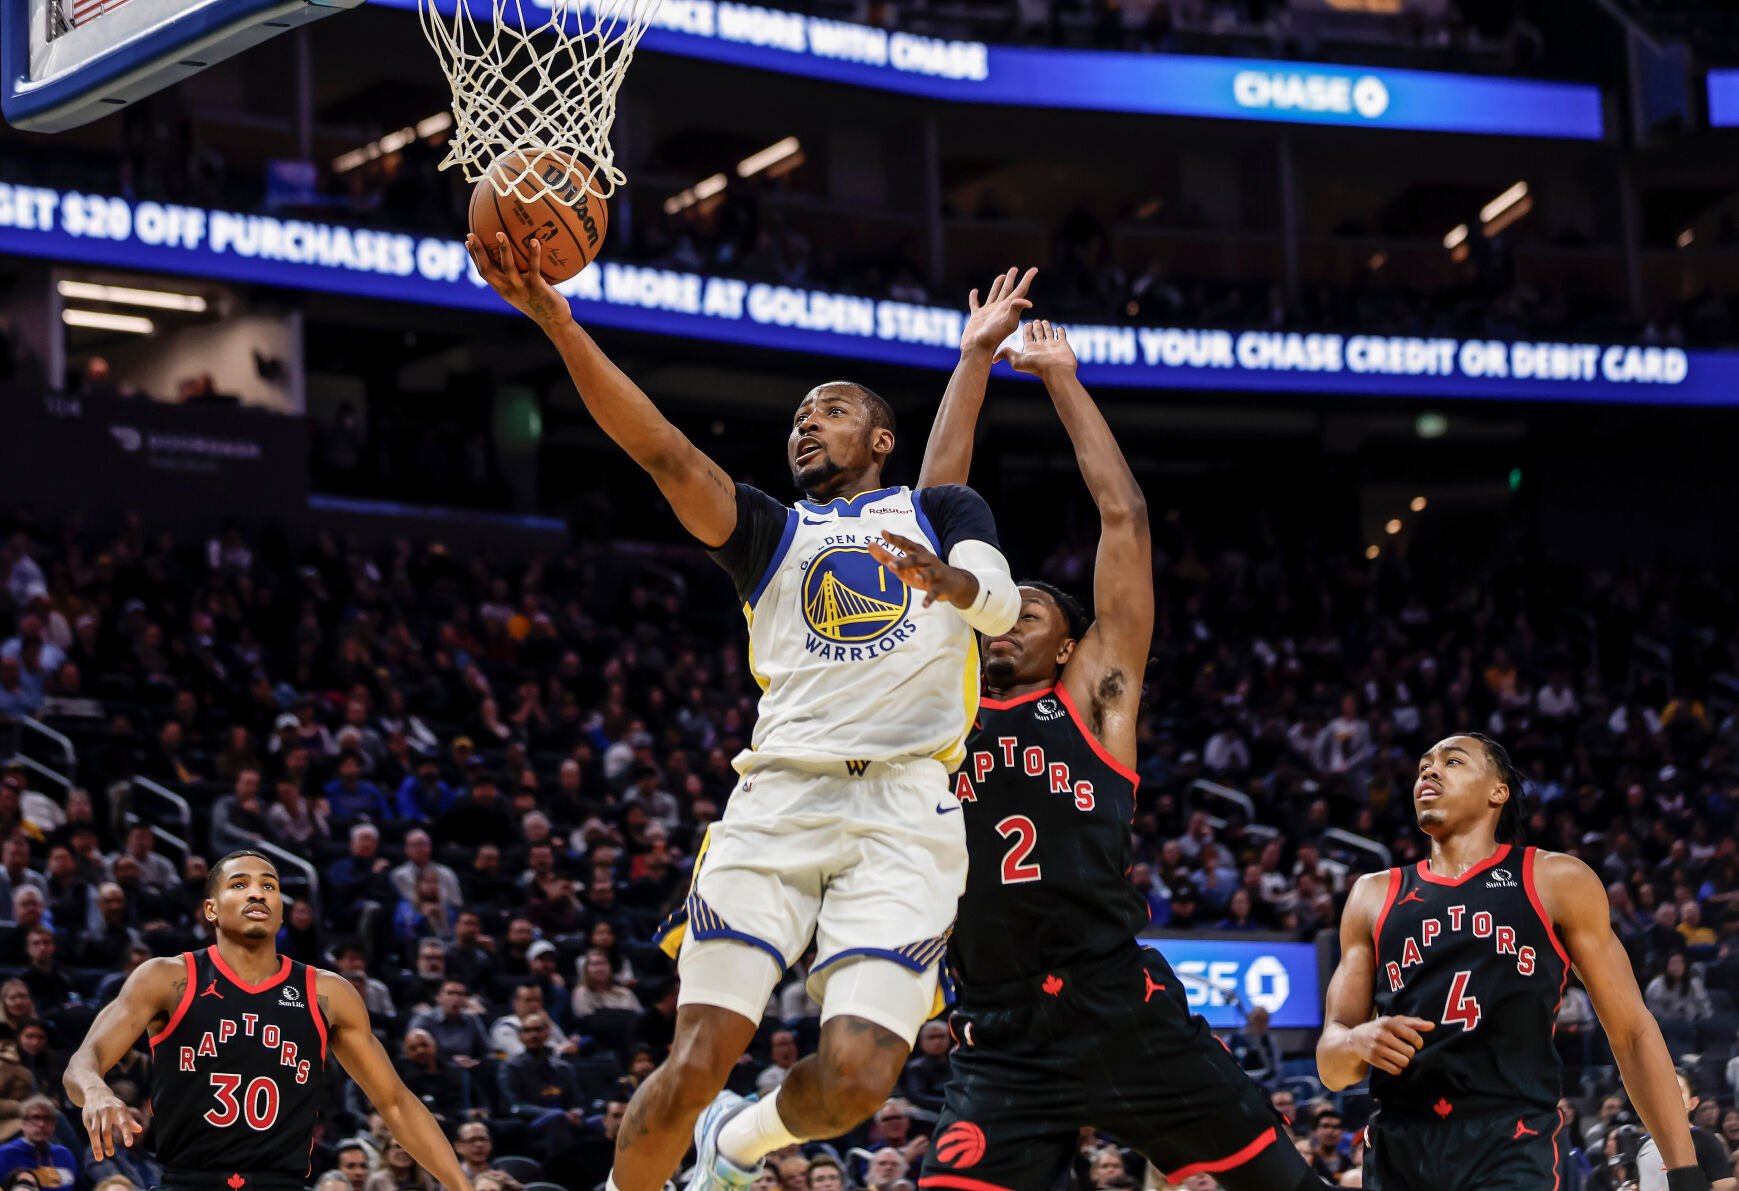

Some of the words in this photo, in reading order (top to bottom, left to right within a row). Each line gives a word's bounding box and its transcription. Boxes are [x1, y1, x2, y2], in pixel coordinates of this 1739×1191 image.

[717, 1, 807, 52] MORE
[808, 16, 888, 67] WITH
[890, 31, 989, 81] CHASE
[1234, 70, 1351, 114] CHASE
[61, 190, 132, 241] $20
[134, 201, 206, 250] OFF
[208, 210, 415, 276] PURCHASES
[417, 238, 466, 282] OF
[603, 262, 702, 314] MORE
[703, 276, 747, 319] AT
[748, 283, 875, 336] GOLDEN
[876, 301, 963, 349] STATE
[1138, 327, 1235, 369] YOUR
[1236, 331, 1344, 373] CHASE
[1345, 335, 1458, 376] CREDIT
[1459, 339, 1509, 378] OR
[1510, 341, 1600, 382] DEBIT
[1601, 345, 1688, 384] CARD
[869, 507, 912, 515] Rakuten
[800, 534, 856, 571] GDEN
[805, 618, 917, 662] WARRIORS
[955, 736, 1095, 812] APTORS
[994, 814, 1041, 885] 2
[1385, 904, 1536, 992] RAPTORS
[291, 1001, 305, 1009] Life
[1441, 970, 1481, 1032] 4
[180, 1013, 310, 1084] RAPTORS
[203, 1072, 280, 1131] 30
